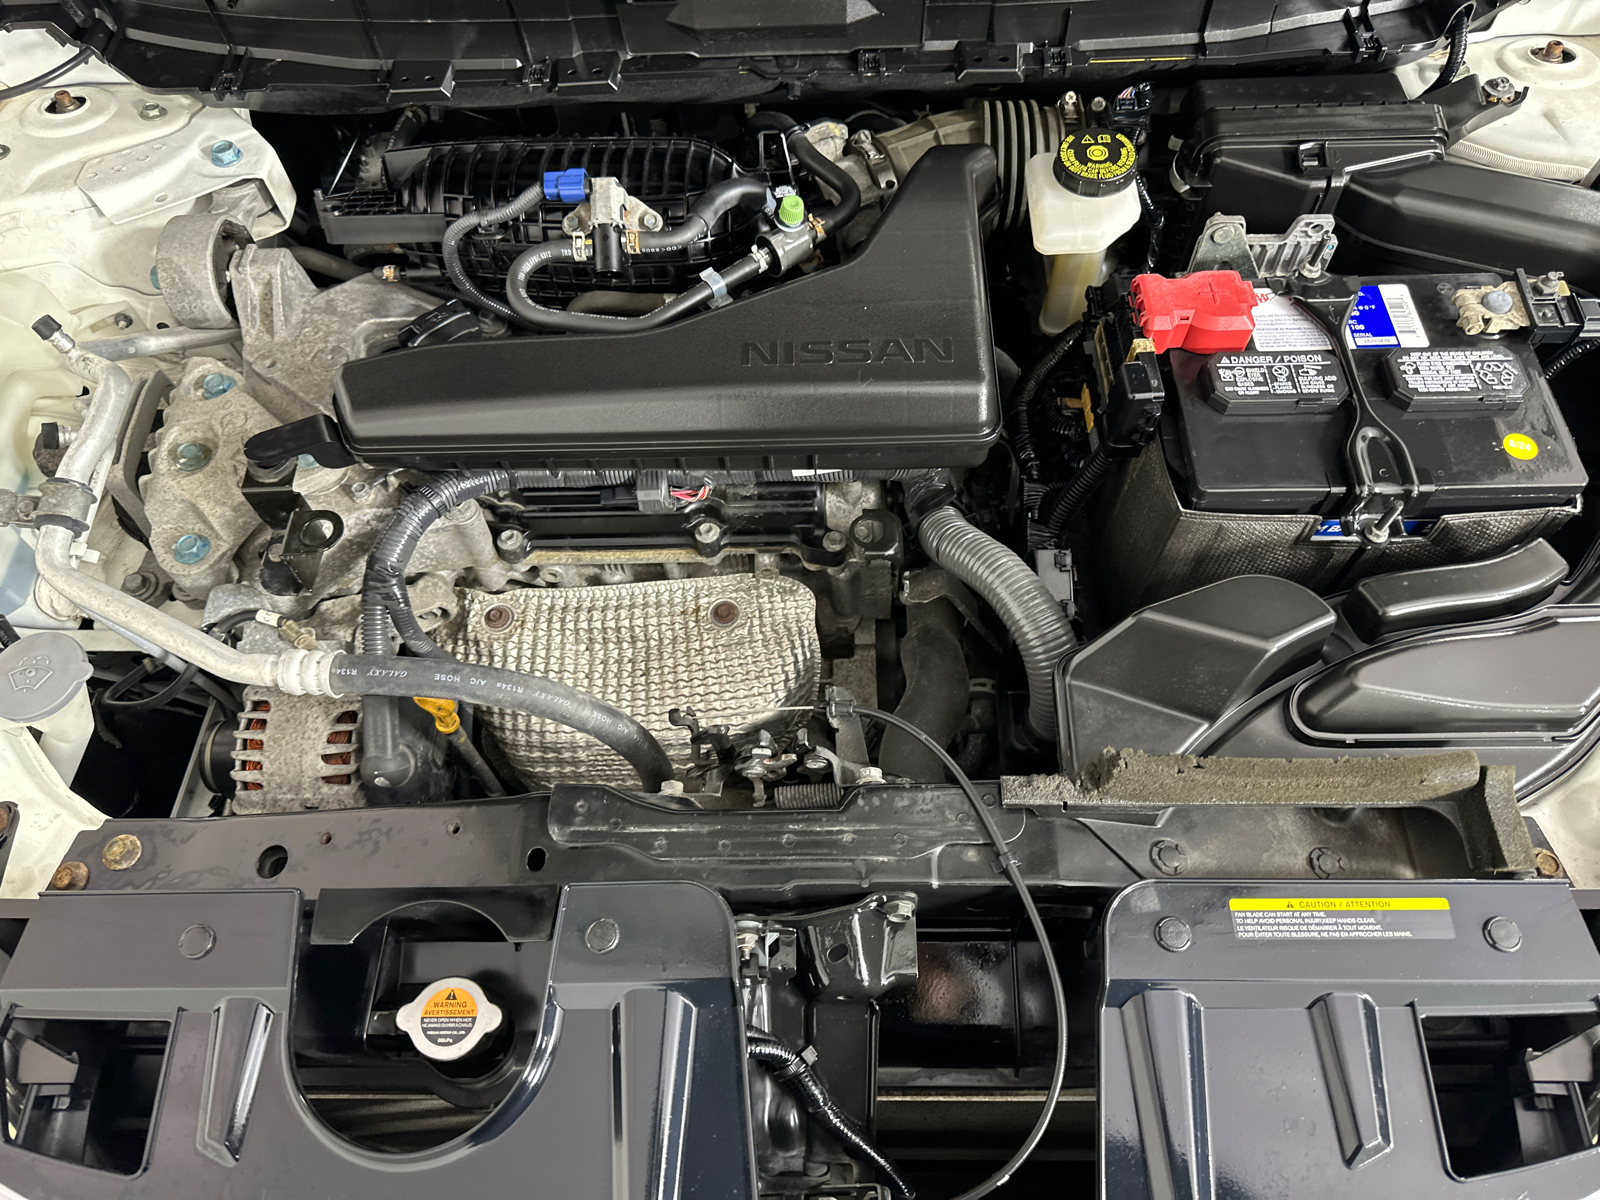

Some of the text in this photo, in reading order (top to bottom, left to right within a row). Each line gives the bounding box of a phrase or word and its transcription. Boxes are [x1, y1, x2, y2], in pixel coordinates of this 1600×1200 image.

[1087, 161, 1113, 170] WARNING
[741, 336, 954, 367] NISSAN
[1231, 355, 1273, 364] DANGER
[1283, 355, 1322, 363] POISON
[367, 669, 408, 678] GALAXY
[434, 673, 460, 682] HOSE
[470, 678, 487, 686] A/C
[496, 682, 524, 694] R134a
[532, 690, 571, 707] GALAXY
[591, 710, 612, 725] HOSE
[617, 723, 630, 734] A/C
[1299, 901, 1336, 909] CAUTION
[1255, 930, 1273, 938] ÉVITER
